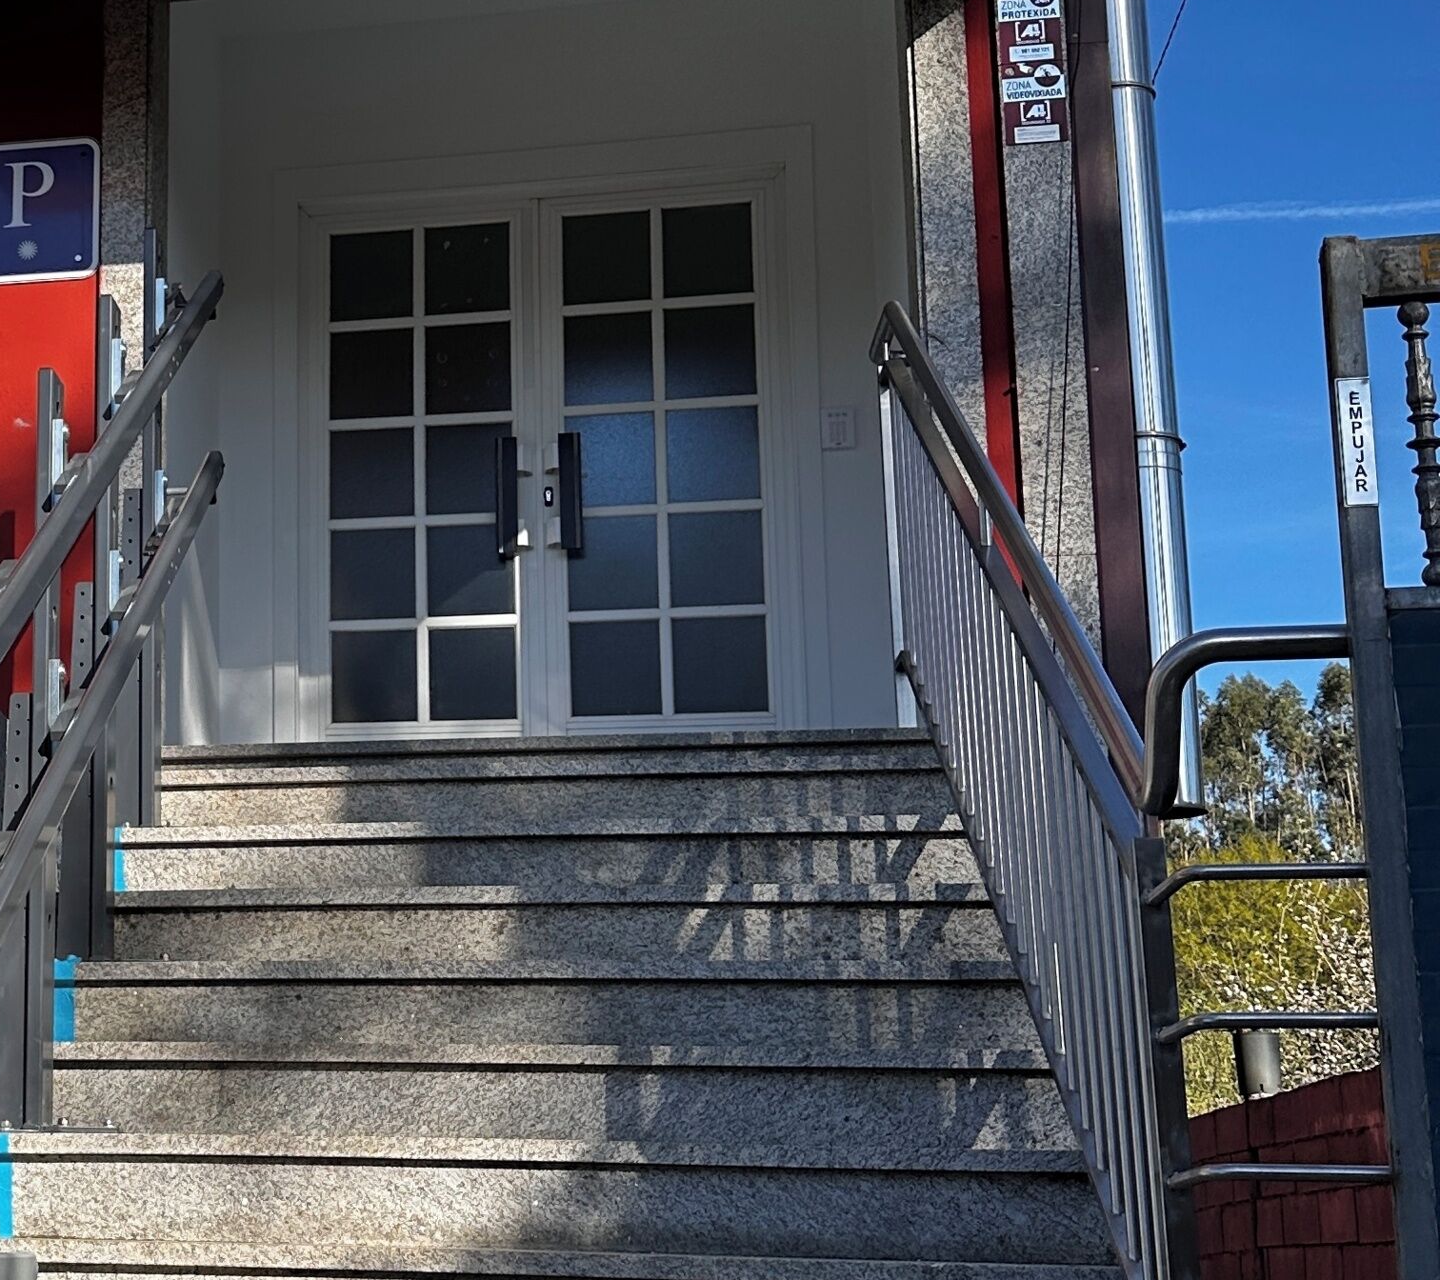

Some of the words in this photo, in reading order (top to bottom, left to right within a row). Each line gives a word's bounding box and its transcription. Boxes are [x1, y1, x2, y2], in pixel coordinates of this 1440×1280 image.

[1000, 0, 1027, 10] ZONA
[1001, 7, 1057, 20] PROTEXIDA
[1006, 81, 1032, 91] ZONA
[1006, 88, 1063, 100] VIDEOVIXIADA
[3, 161, 55, 229] P
[1348, 391, 1369, 492] EMPUJAR
